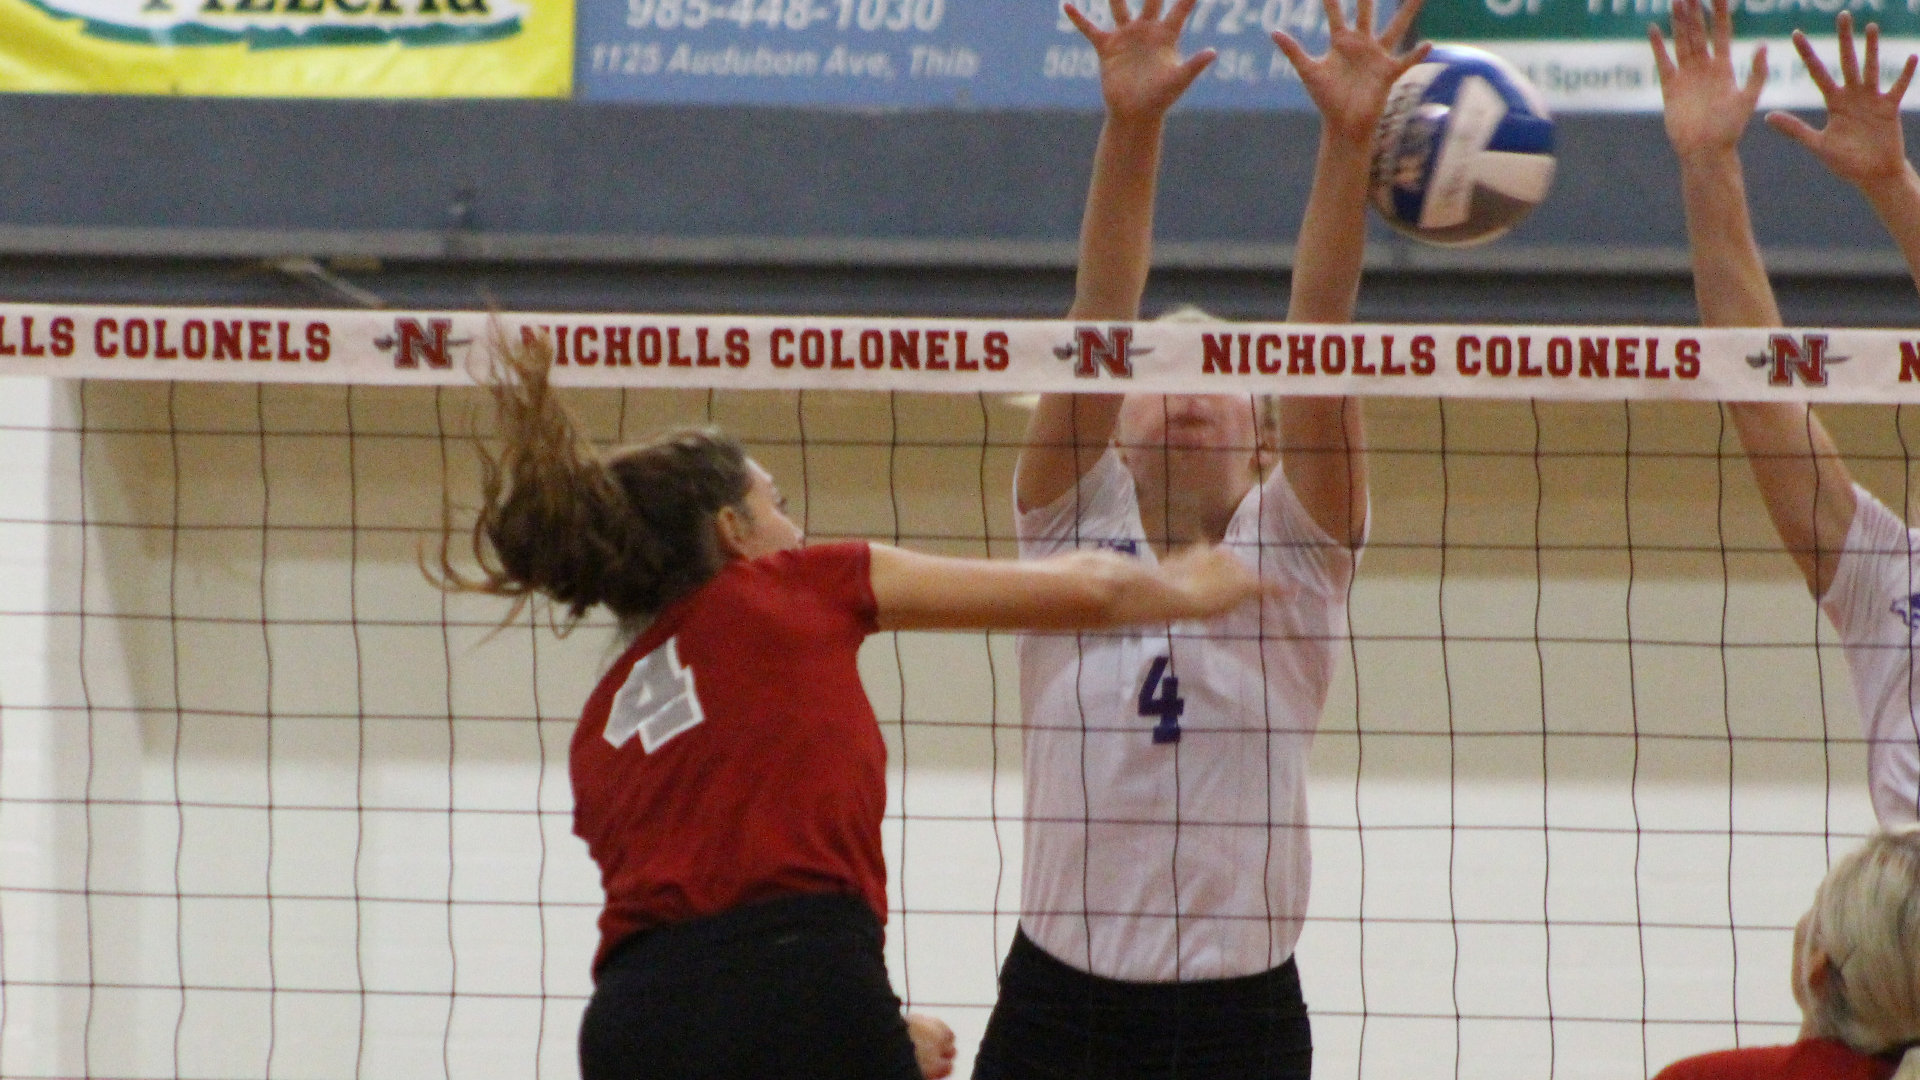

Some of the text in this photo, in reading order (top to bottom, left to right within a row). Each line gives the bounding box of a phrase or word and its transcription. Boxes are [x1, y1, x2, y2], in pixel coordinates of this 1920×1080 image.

[94, 318, 331, 362] COLONELS
[394, 318, 453, 370] N
[769, 328, 1010, 372] COLONELS
[1074, 327, 1134, 379] N
[1201, 333, 1701, 380] NICHOLLS COLONELS
[1769, 333, 1828, 386] N
[603, 635, 706, 755] 4
[1138, 656, 1185, 744] 4
